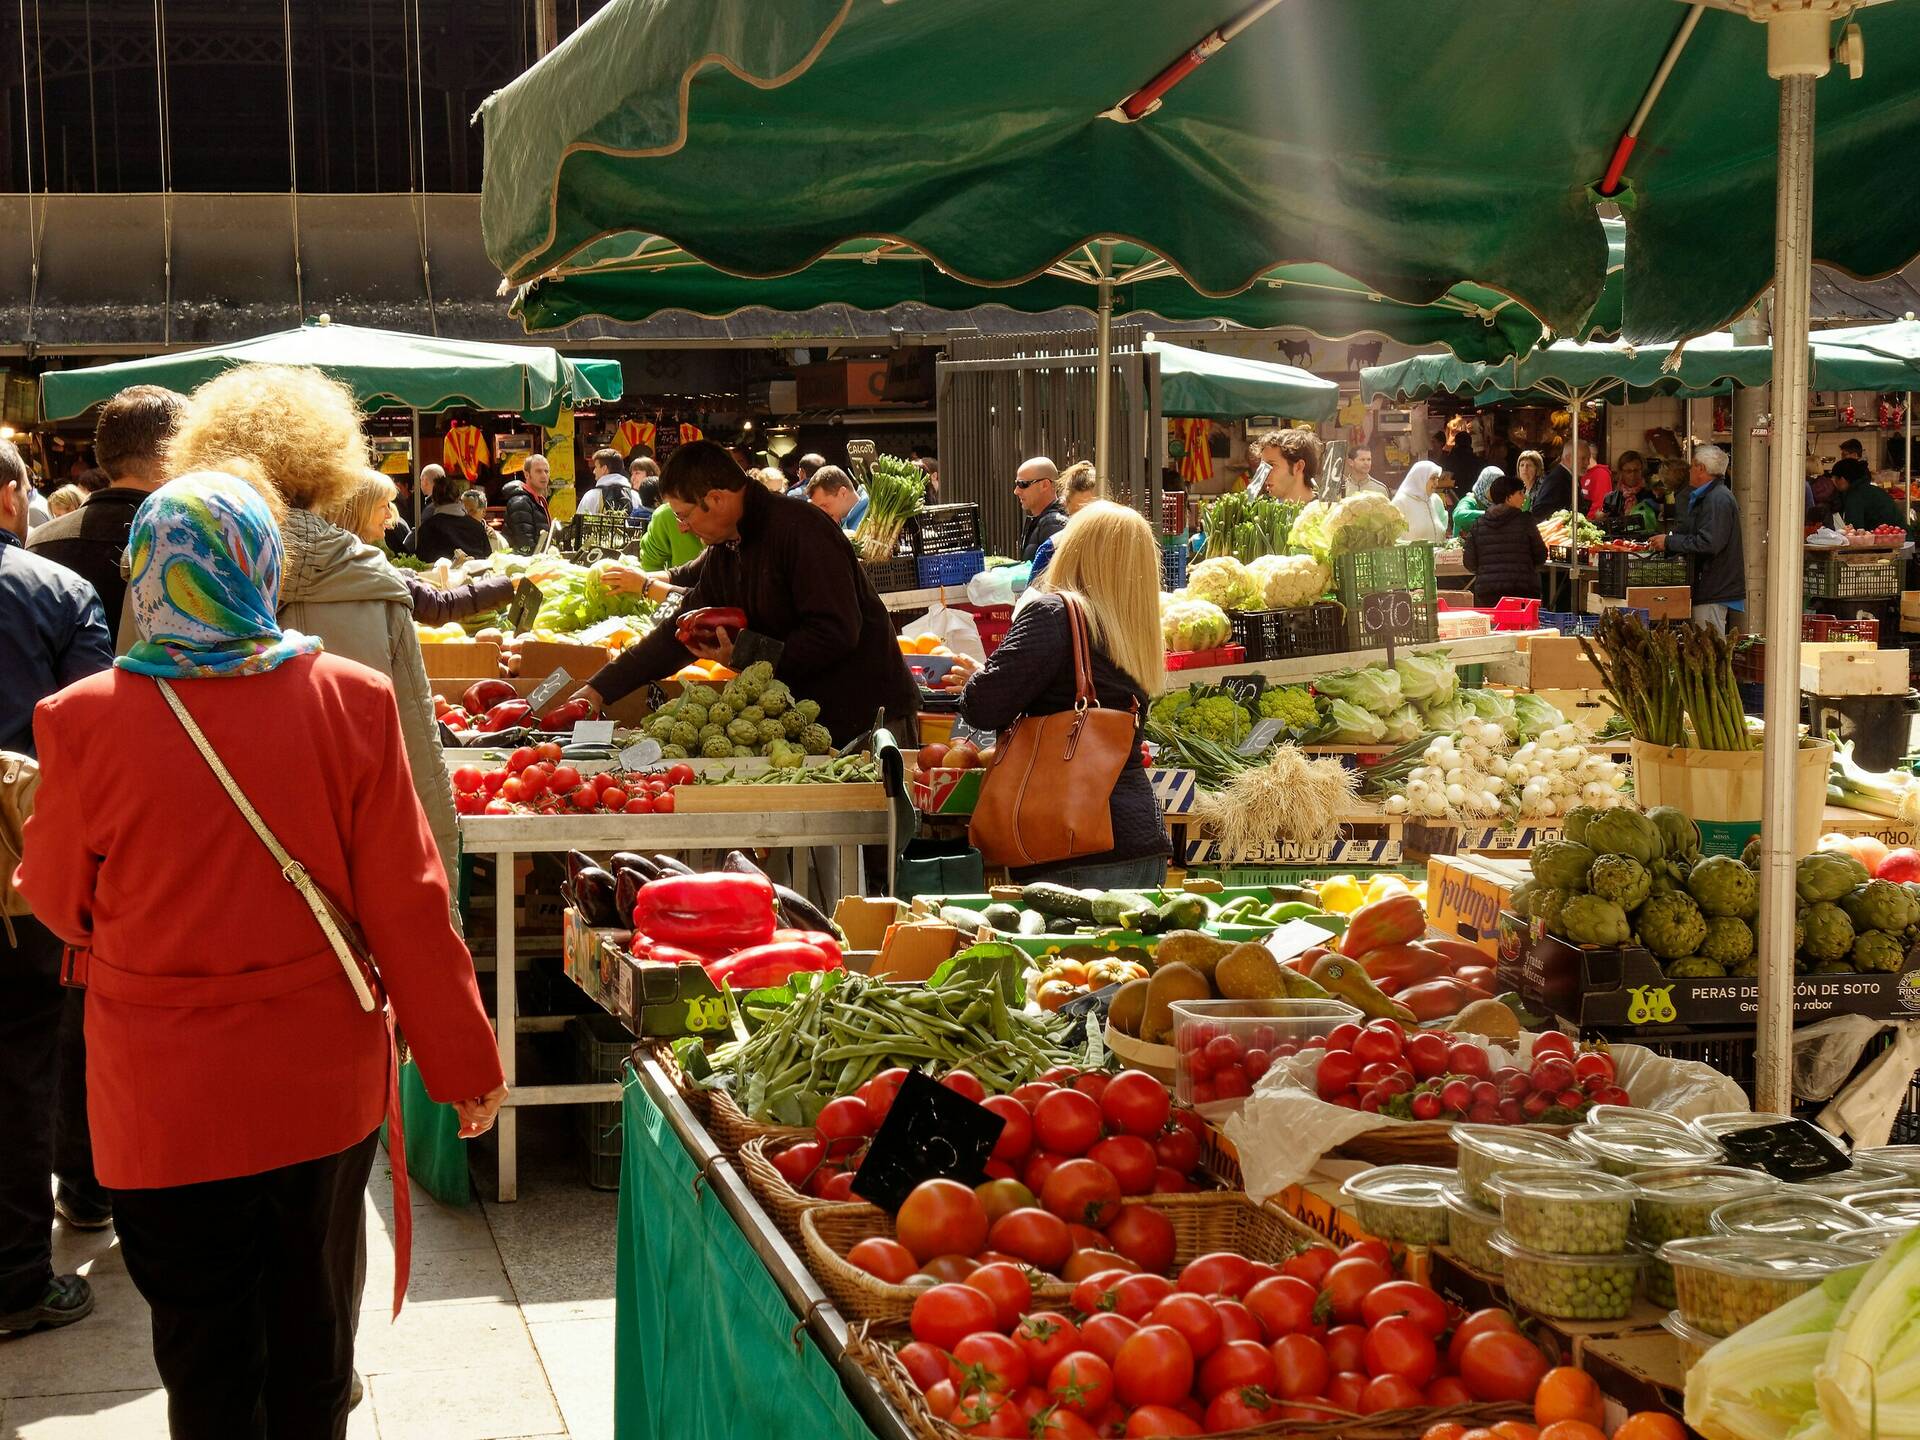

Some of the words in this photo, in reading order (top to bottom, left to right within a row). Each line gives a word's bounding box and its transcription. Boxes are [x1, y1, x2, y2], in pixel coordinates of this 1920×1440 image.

[1692, 987, 1736, 999] PERAS
[1821, 984, 1839, 995] DE
[1843, 983, 1881, 995] SOTO
[1803, 998, 1833, 1010] sabor
